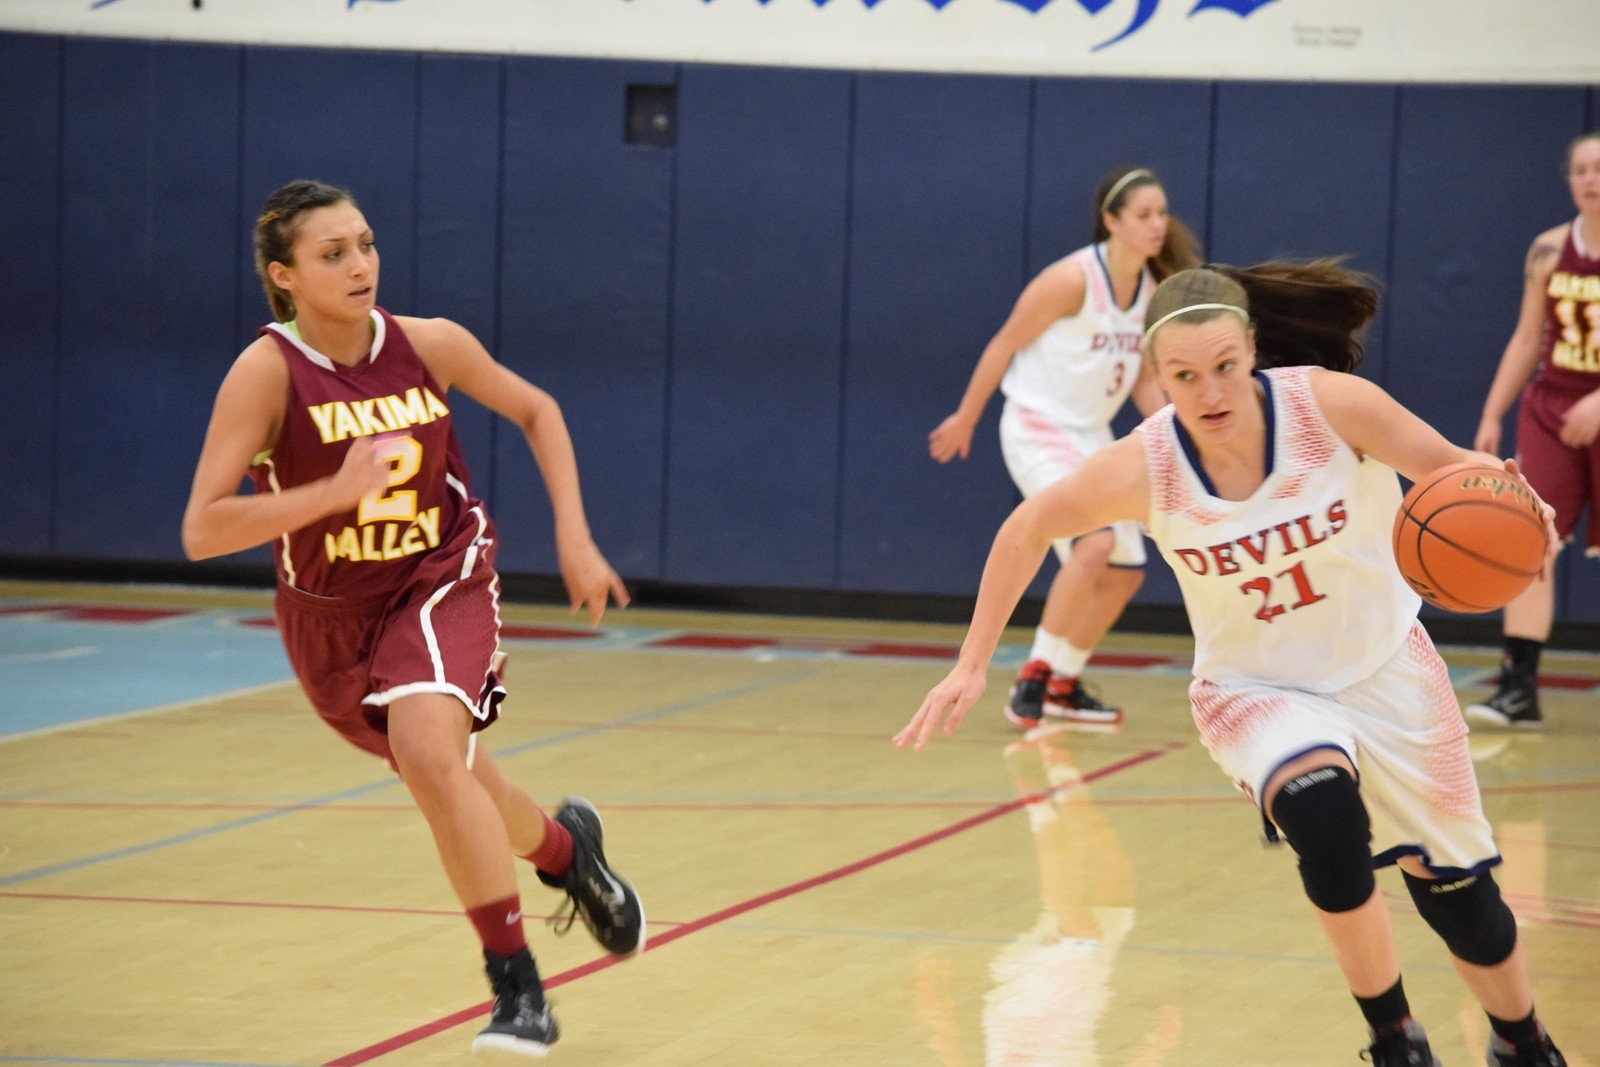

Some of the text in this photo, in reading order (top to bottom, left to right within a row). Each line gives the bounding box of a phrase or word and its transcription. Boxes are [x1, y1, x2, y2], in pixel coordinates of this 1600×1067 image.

[1105, 360, 1126, 397] 3
[307, 386, 449, 444] YAKIMA
[357, 433, 423, 526] 2
[1173, 499, 1347, 576] DEVILS
[1239, 560, 1327, 624] 21
